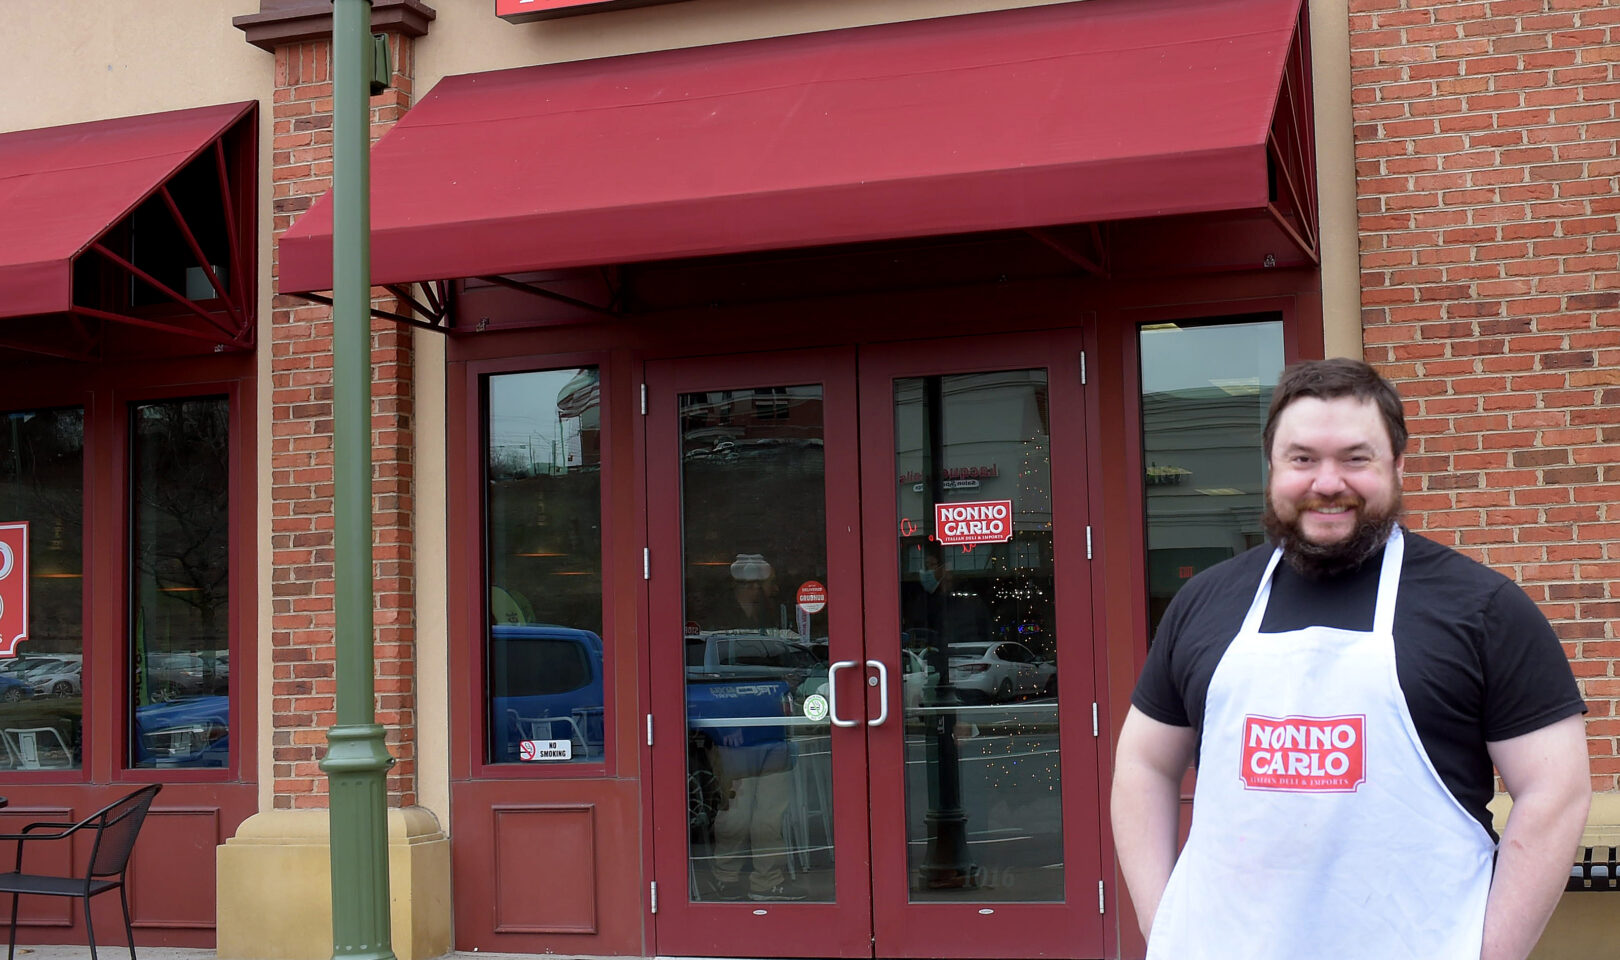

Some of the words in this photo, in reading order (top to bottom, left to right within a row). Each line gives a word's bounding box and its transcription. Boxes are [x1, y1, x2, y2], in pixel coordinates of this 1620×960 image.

[941, 505, 1007, 522] NONNO
[944, 520, 1004, 536] CARLO
[1248, 723, 1357, 750] NONNO
[540, 750, 566, 758] SMOKING
[1250, 751, 1350, 777] CARLO
[1280, 777, 1299, 785] DELI
[1310, 777, 1349, 786] IMPORTS
